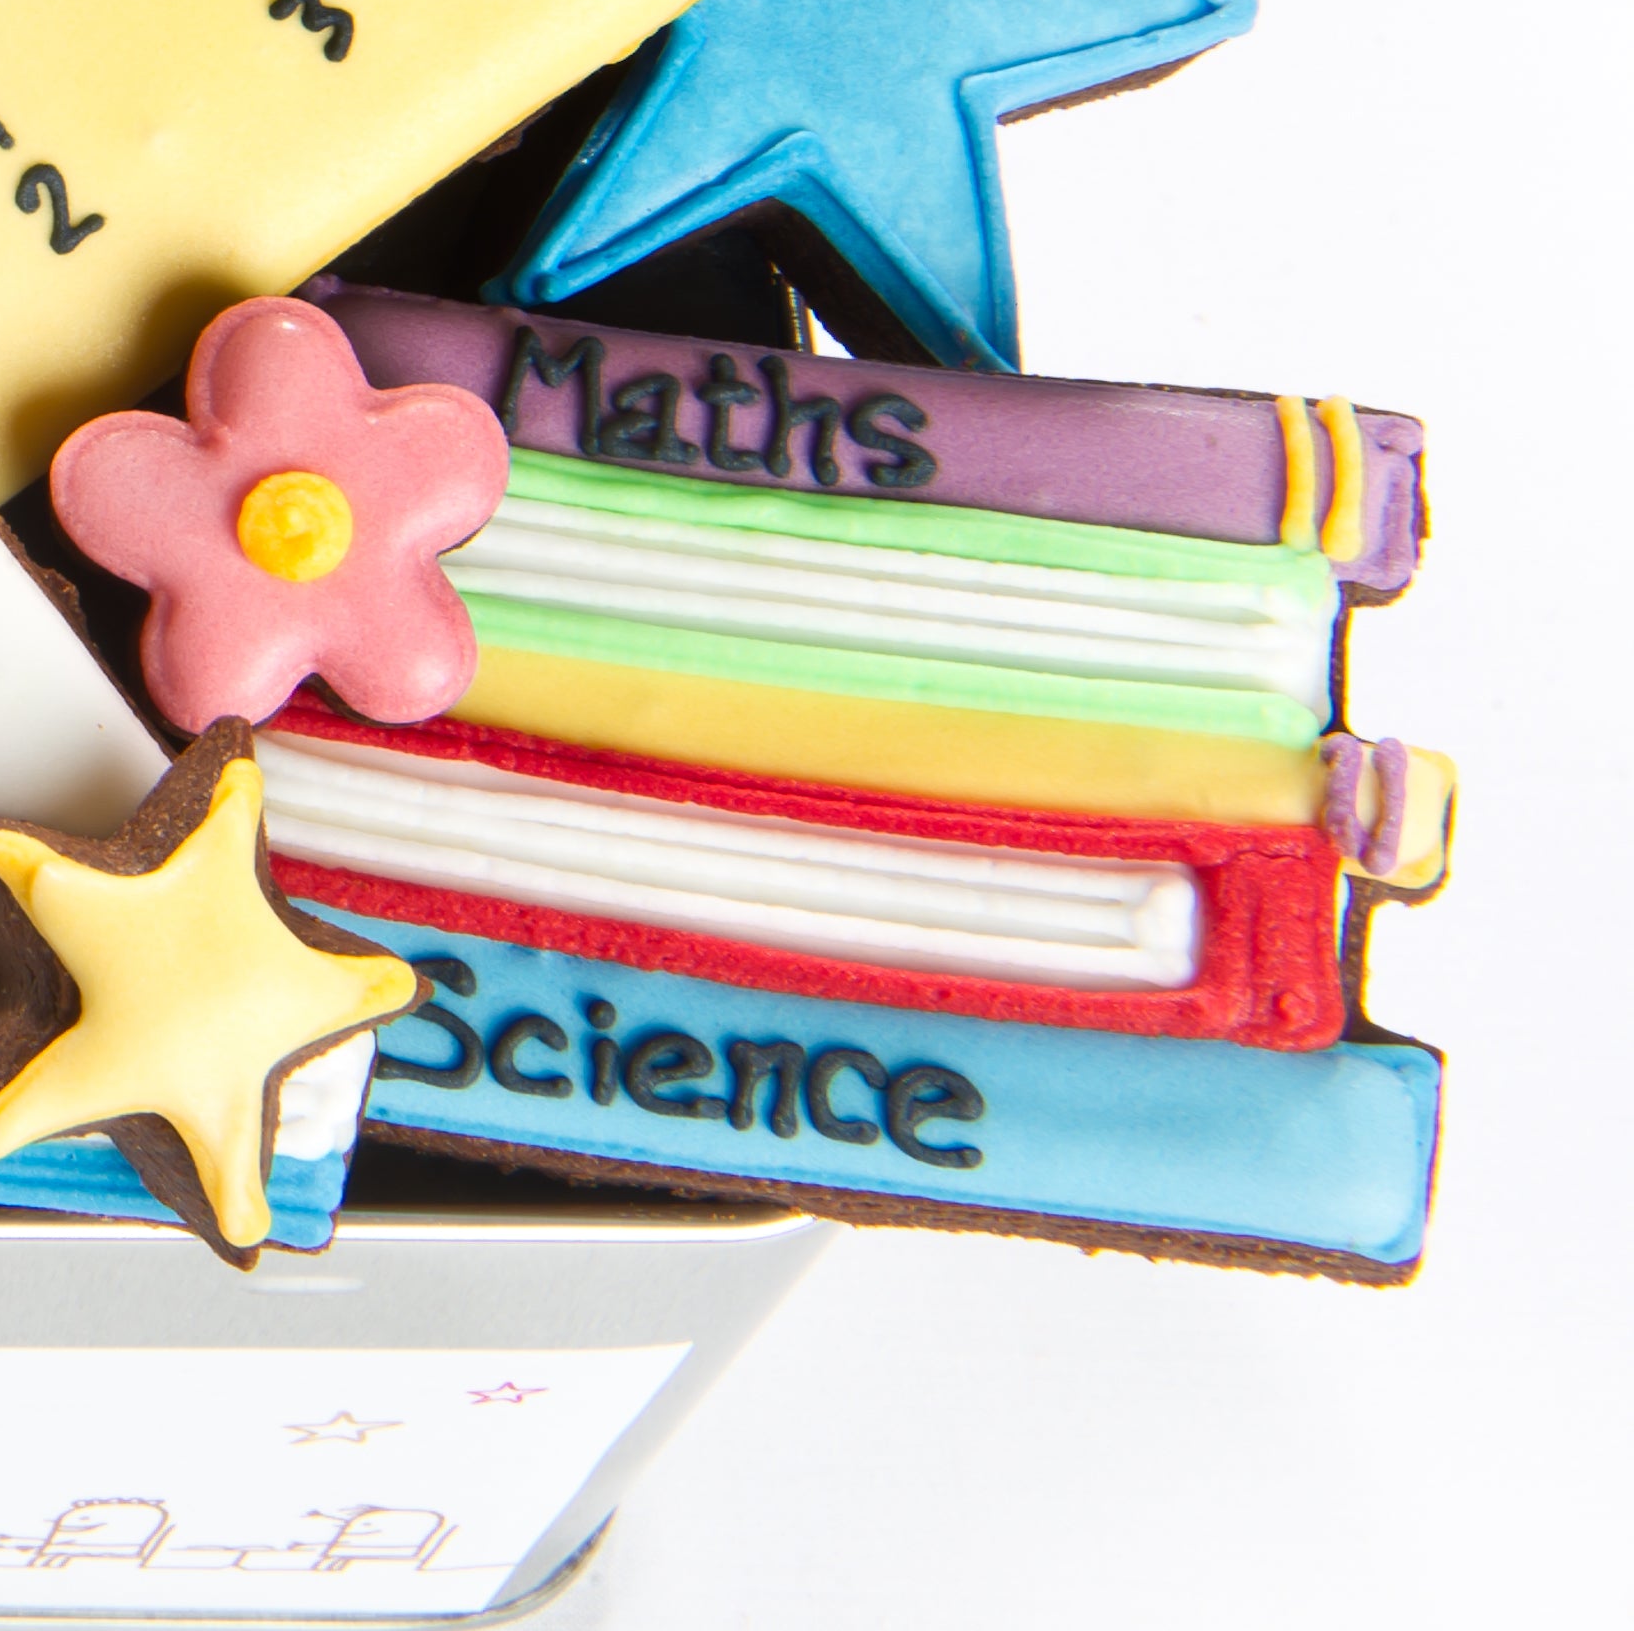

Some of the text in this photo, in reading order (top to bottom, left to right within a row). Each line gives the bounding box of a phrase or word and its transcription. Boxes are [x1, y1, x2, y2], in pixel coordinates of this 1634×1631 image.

[15, 164, 105, 254] 2
[503, 325, 937, 489] Maths
[374, 957, 984, 1168] Science
